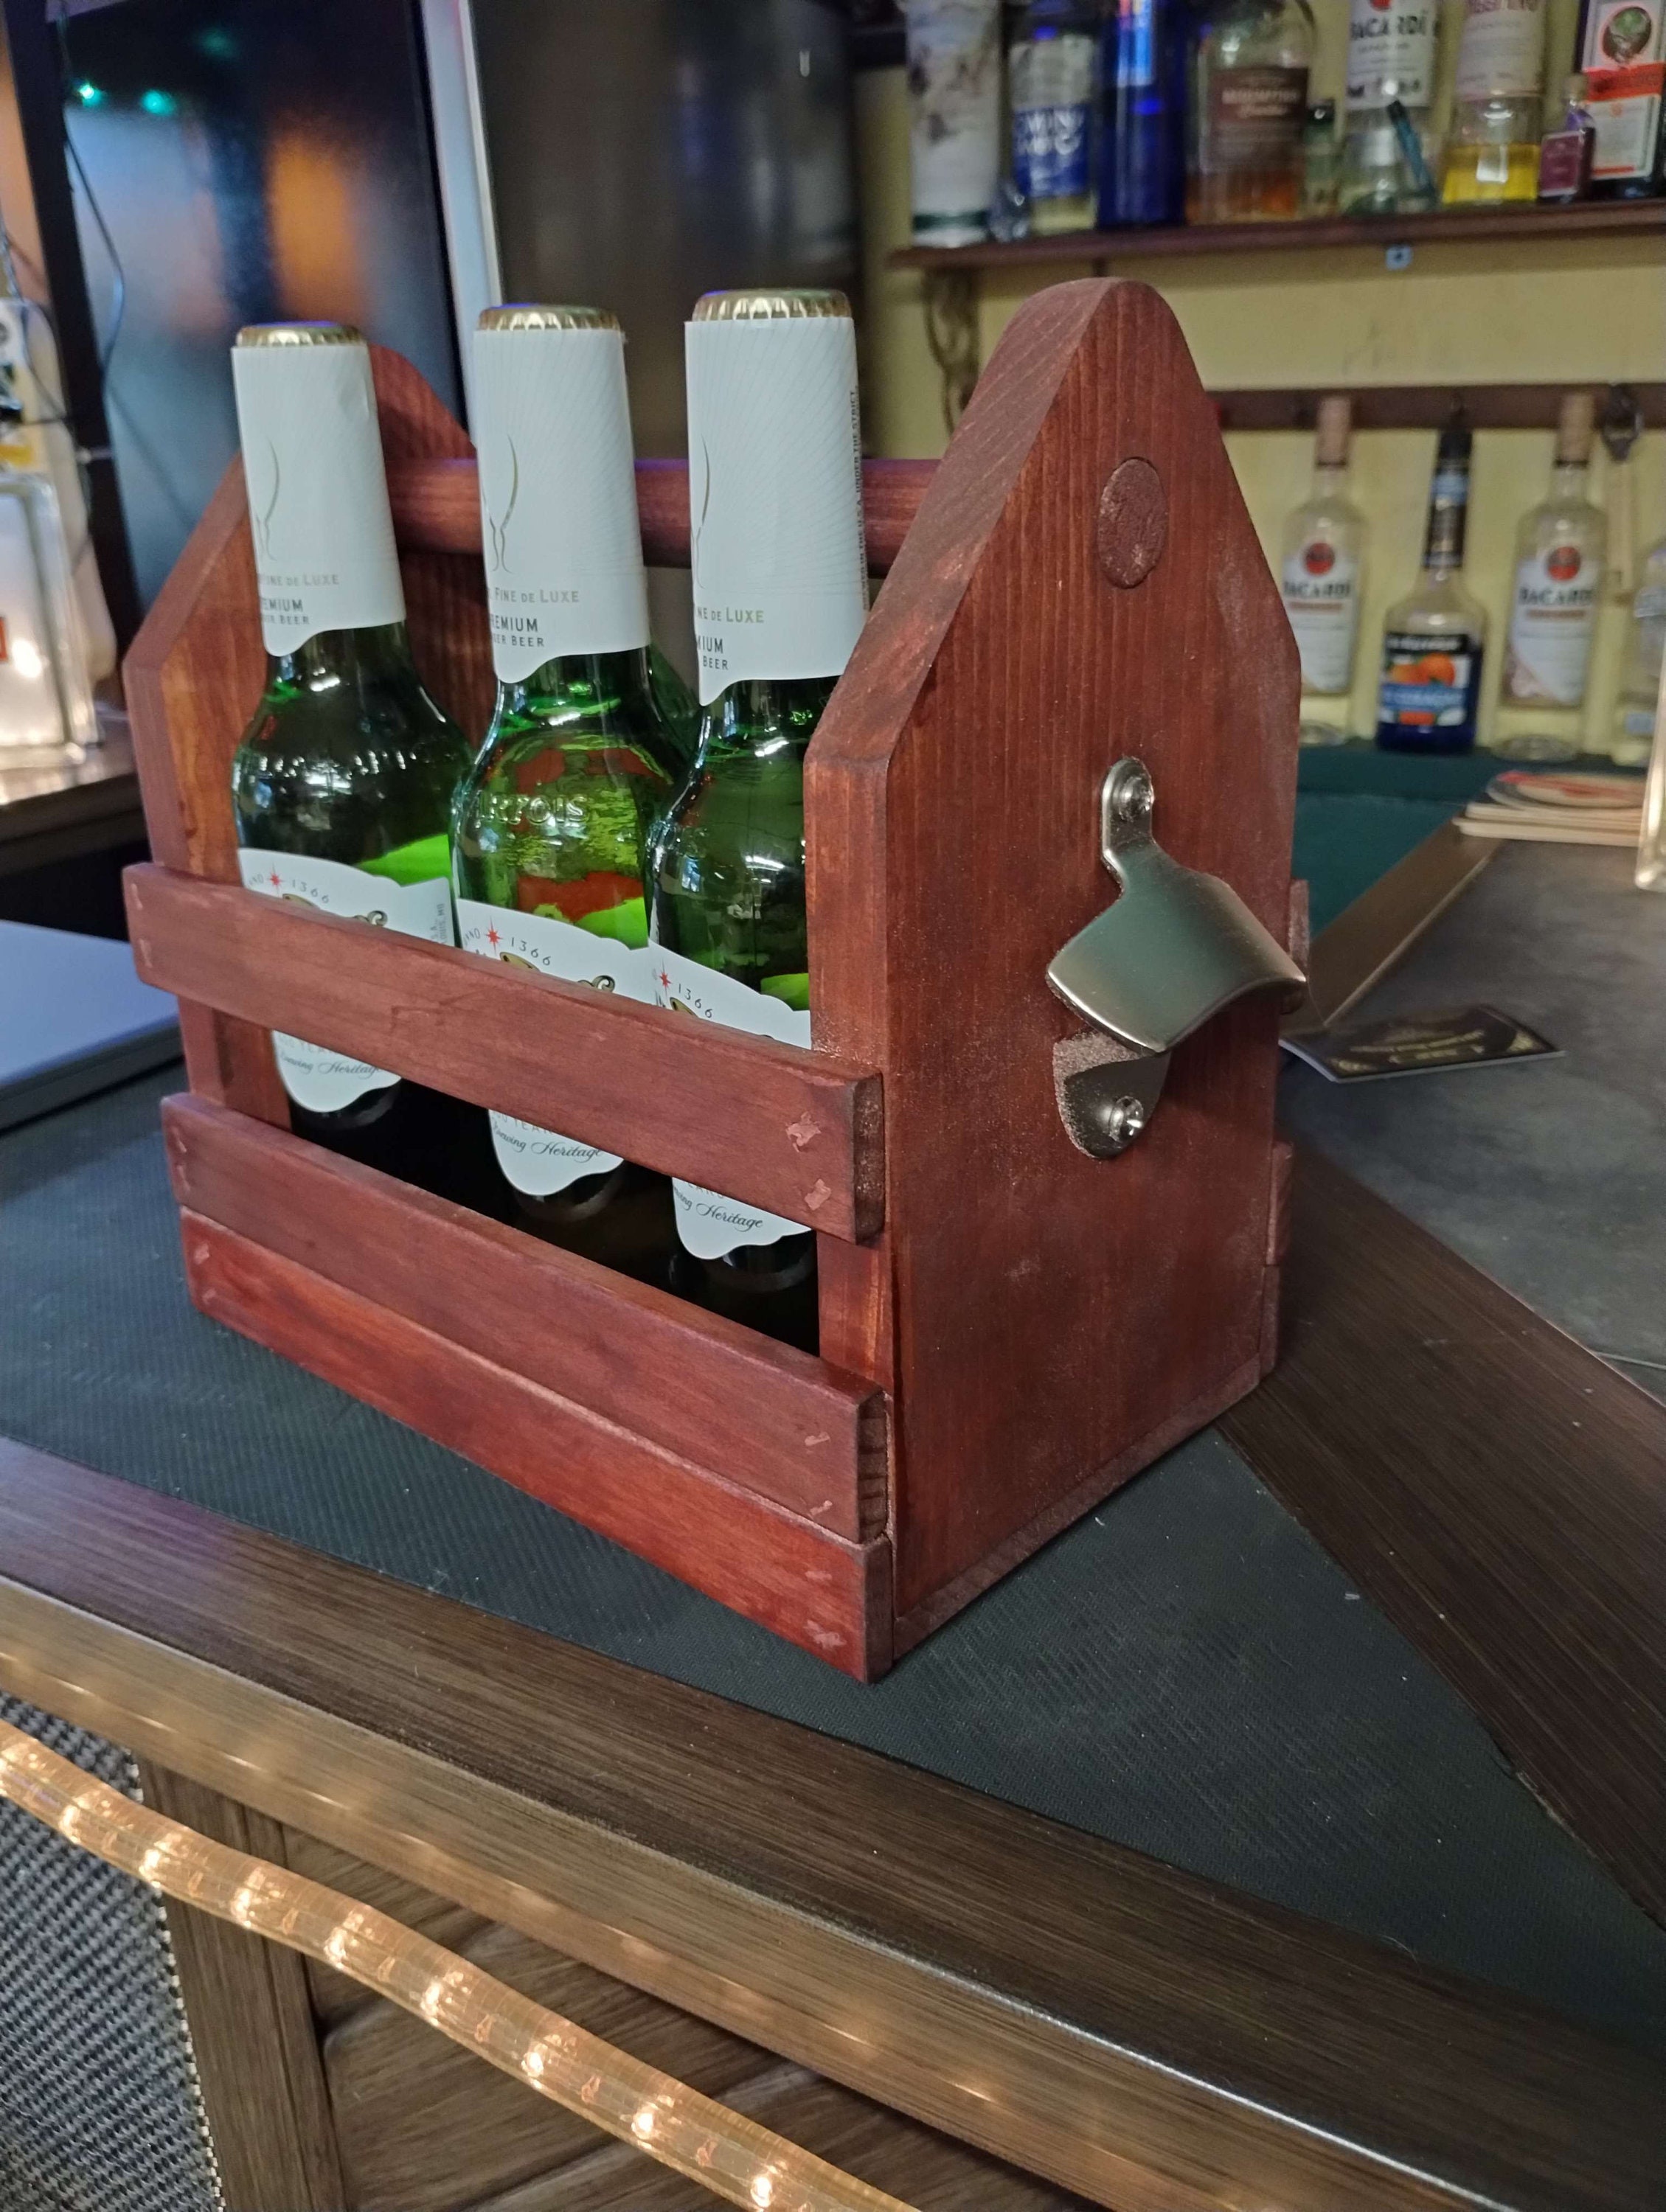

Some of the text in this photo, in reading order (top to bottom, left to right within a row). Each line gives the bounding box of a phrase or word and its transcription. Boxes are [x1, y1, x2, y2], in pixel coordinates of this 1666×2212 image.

[303, 574, 339, 587] LUXE
[495, 587, 517, 603] FINE
[521, 593, 535, 603] DE
[540, 589, 580, 604] LUXE
[280, 615, 310, 625] BEER
[711, 610, 722, 622] DE
[726, 606, 765, 624] LUXE
[511, 636, 545, 647] BEER
[703, 655, 729, 670] BEER
[291, 879, 330, 905] 1366
[510, 936, 552, 967] 1366
[678, 982, 714, 1019] 1366
[695, 1203, 764, 1233] Heritage
